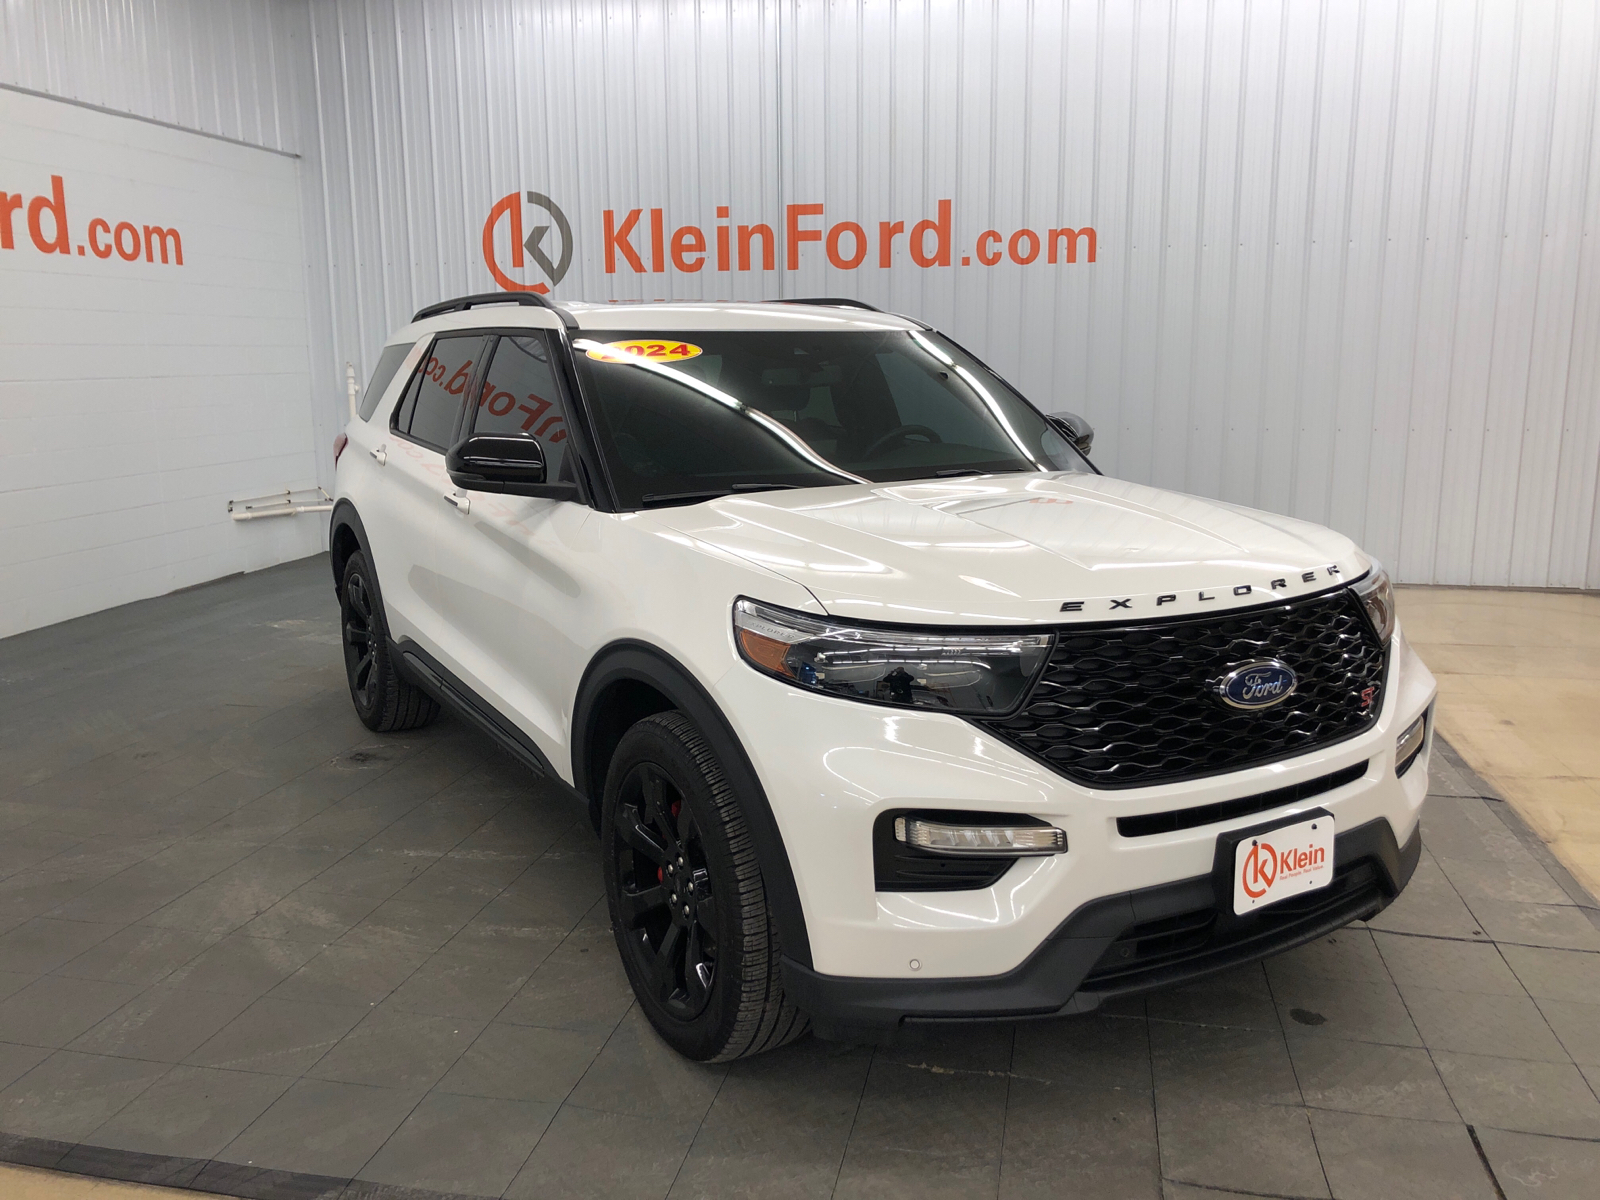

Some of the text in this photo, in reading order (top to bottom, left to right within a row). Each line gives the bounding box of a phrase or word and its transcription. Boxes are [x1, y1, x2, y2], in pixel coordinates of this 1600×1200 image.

[603, 199, 1097, 274] KleinFord.com
[1059, 565, 1341, 612] EXPLORER
[1242, 671, 1284, 700] Ford
[1280, 843, 1324, 874] Klein
